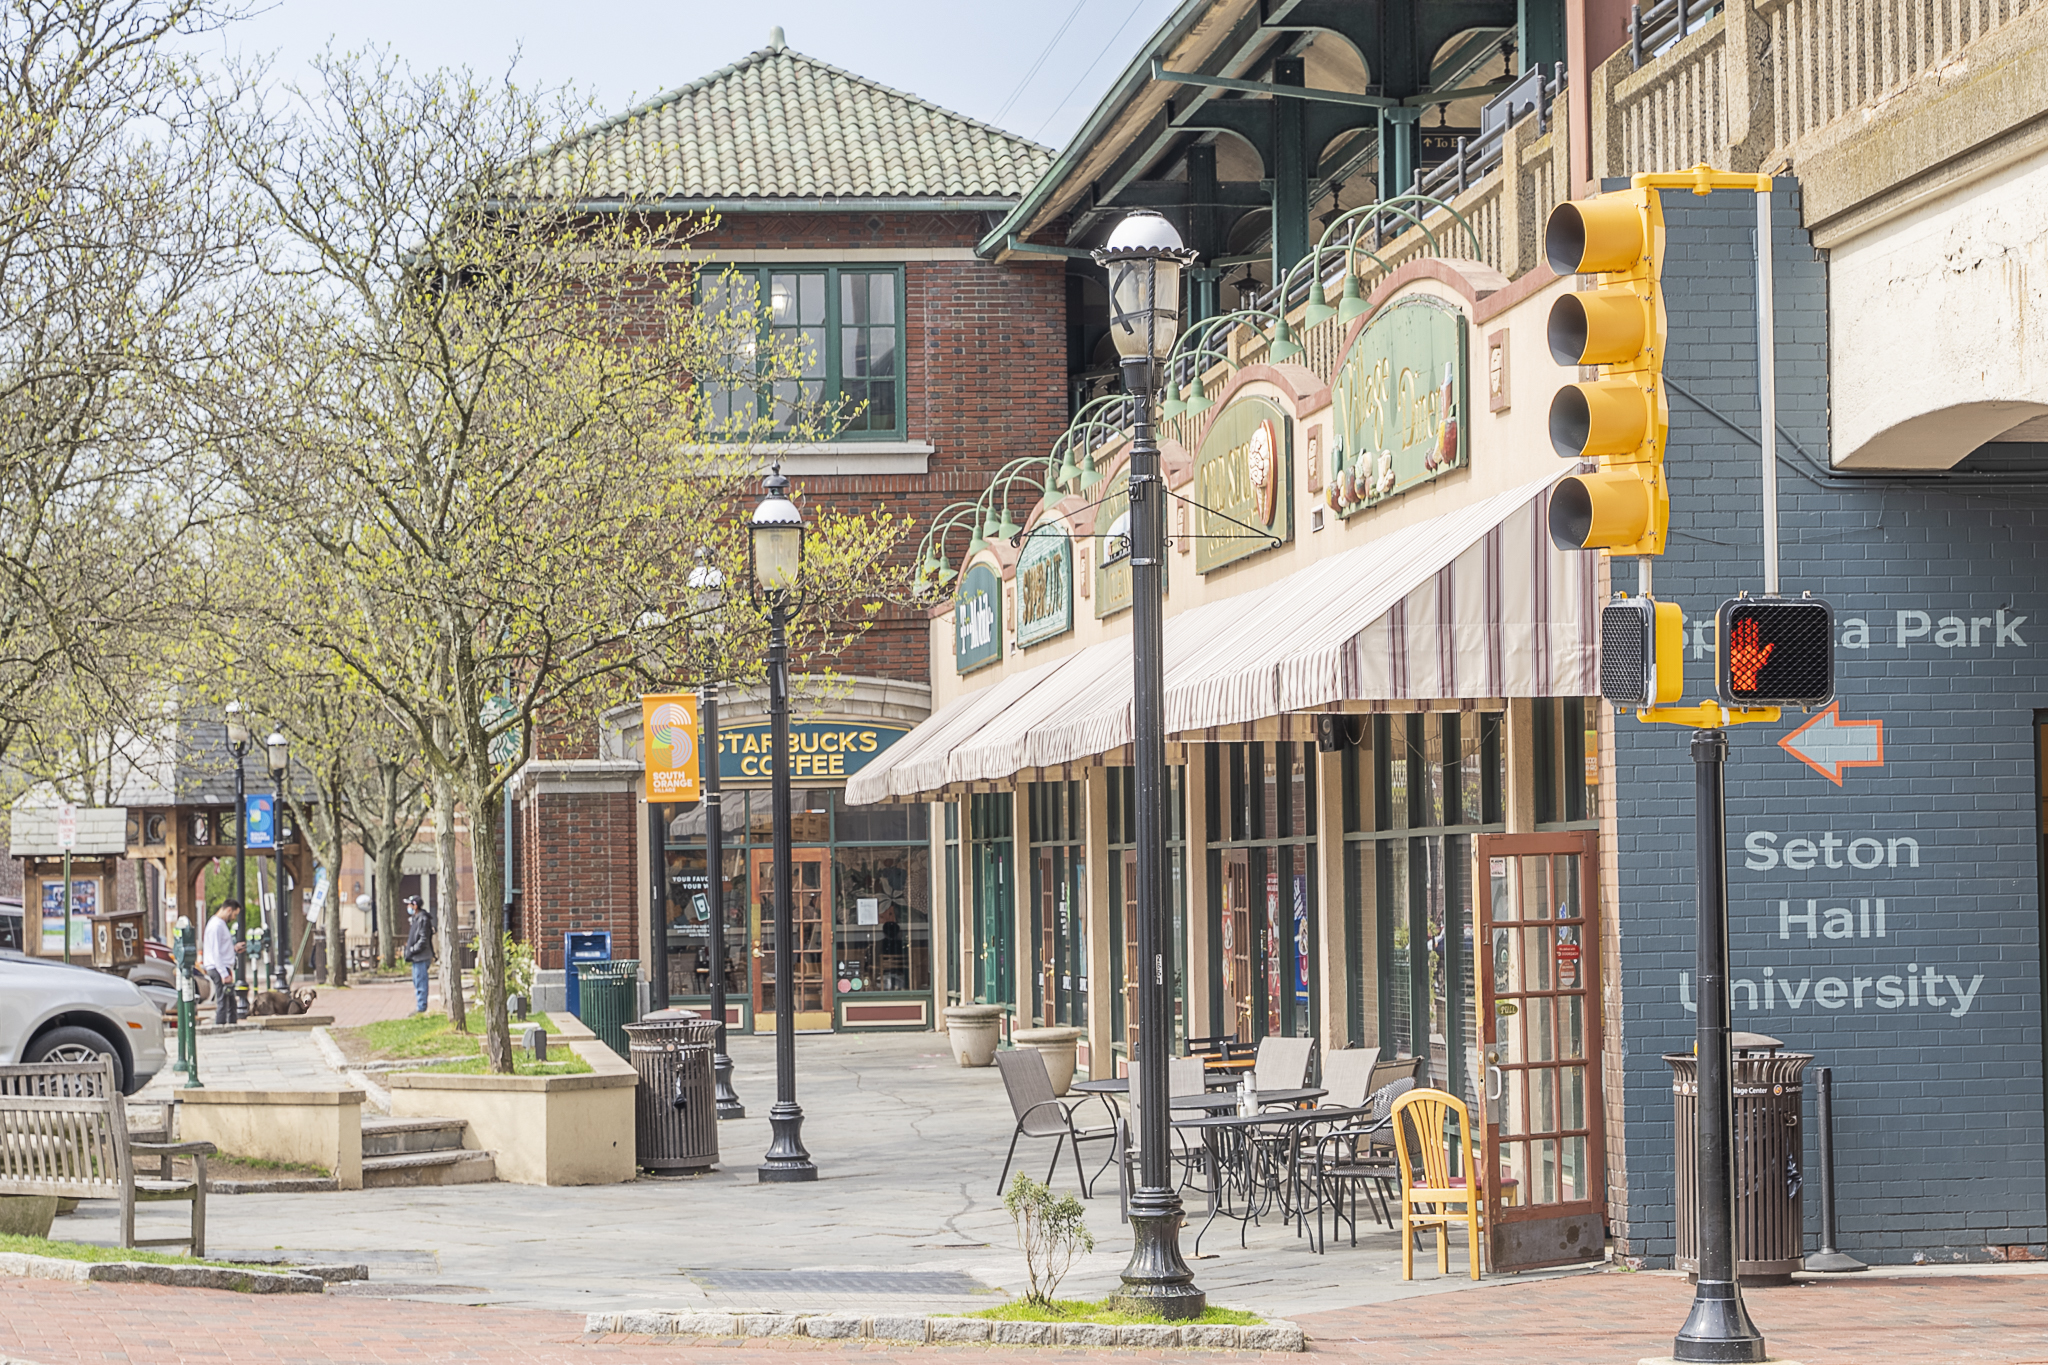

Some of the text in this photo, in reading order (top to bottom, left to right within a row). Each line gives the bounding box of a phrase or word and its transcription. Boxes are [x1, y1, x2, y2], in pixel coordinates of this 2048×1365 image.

[1434, 137, 1448, 148] To
[1339, 338, 1390, 461] Village
[1896, 608, 2028, 649] Park
[740, 754, 845, 776] COFEE
[653, 771, 685, 780] SOUTH
[653, 779, 693, 788] ORANGE
[1744, 830, 1920, 871] Seton
[1778, 898, 1886, 939] Hall
[1500, 1004, 1517, 1014] PULL
[1733, 1086, 1768, 1096] llage Center
